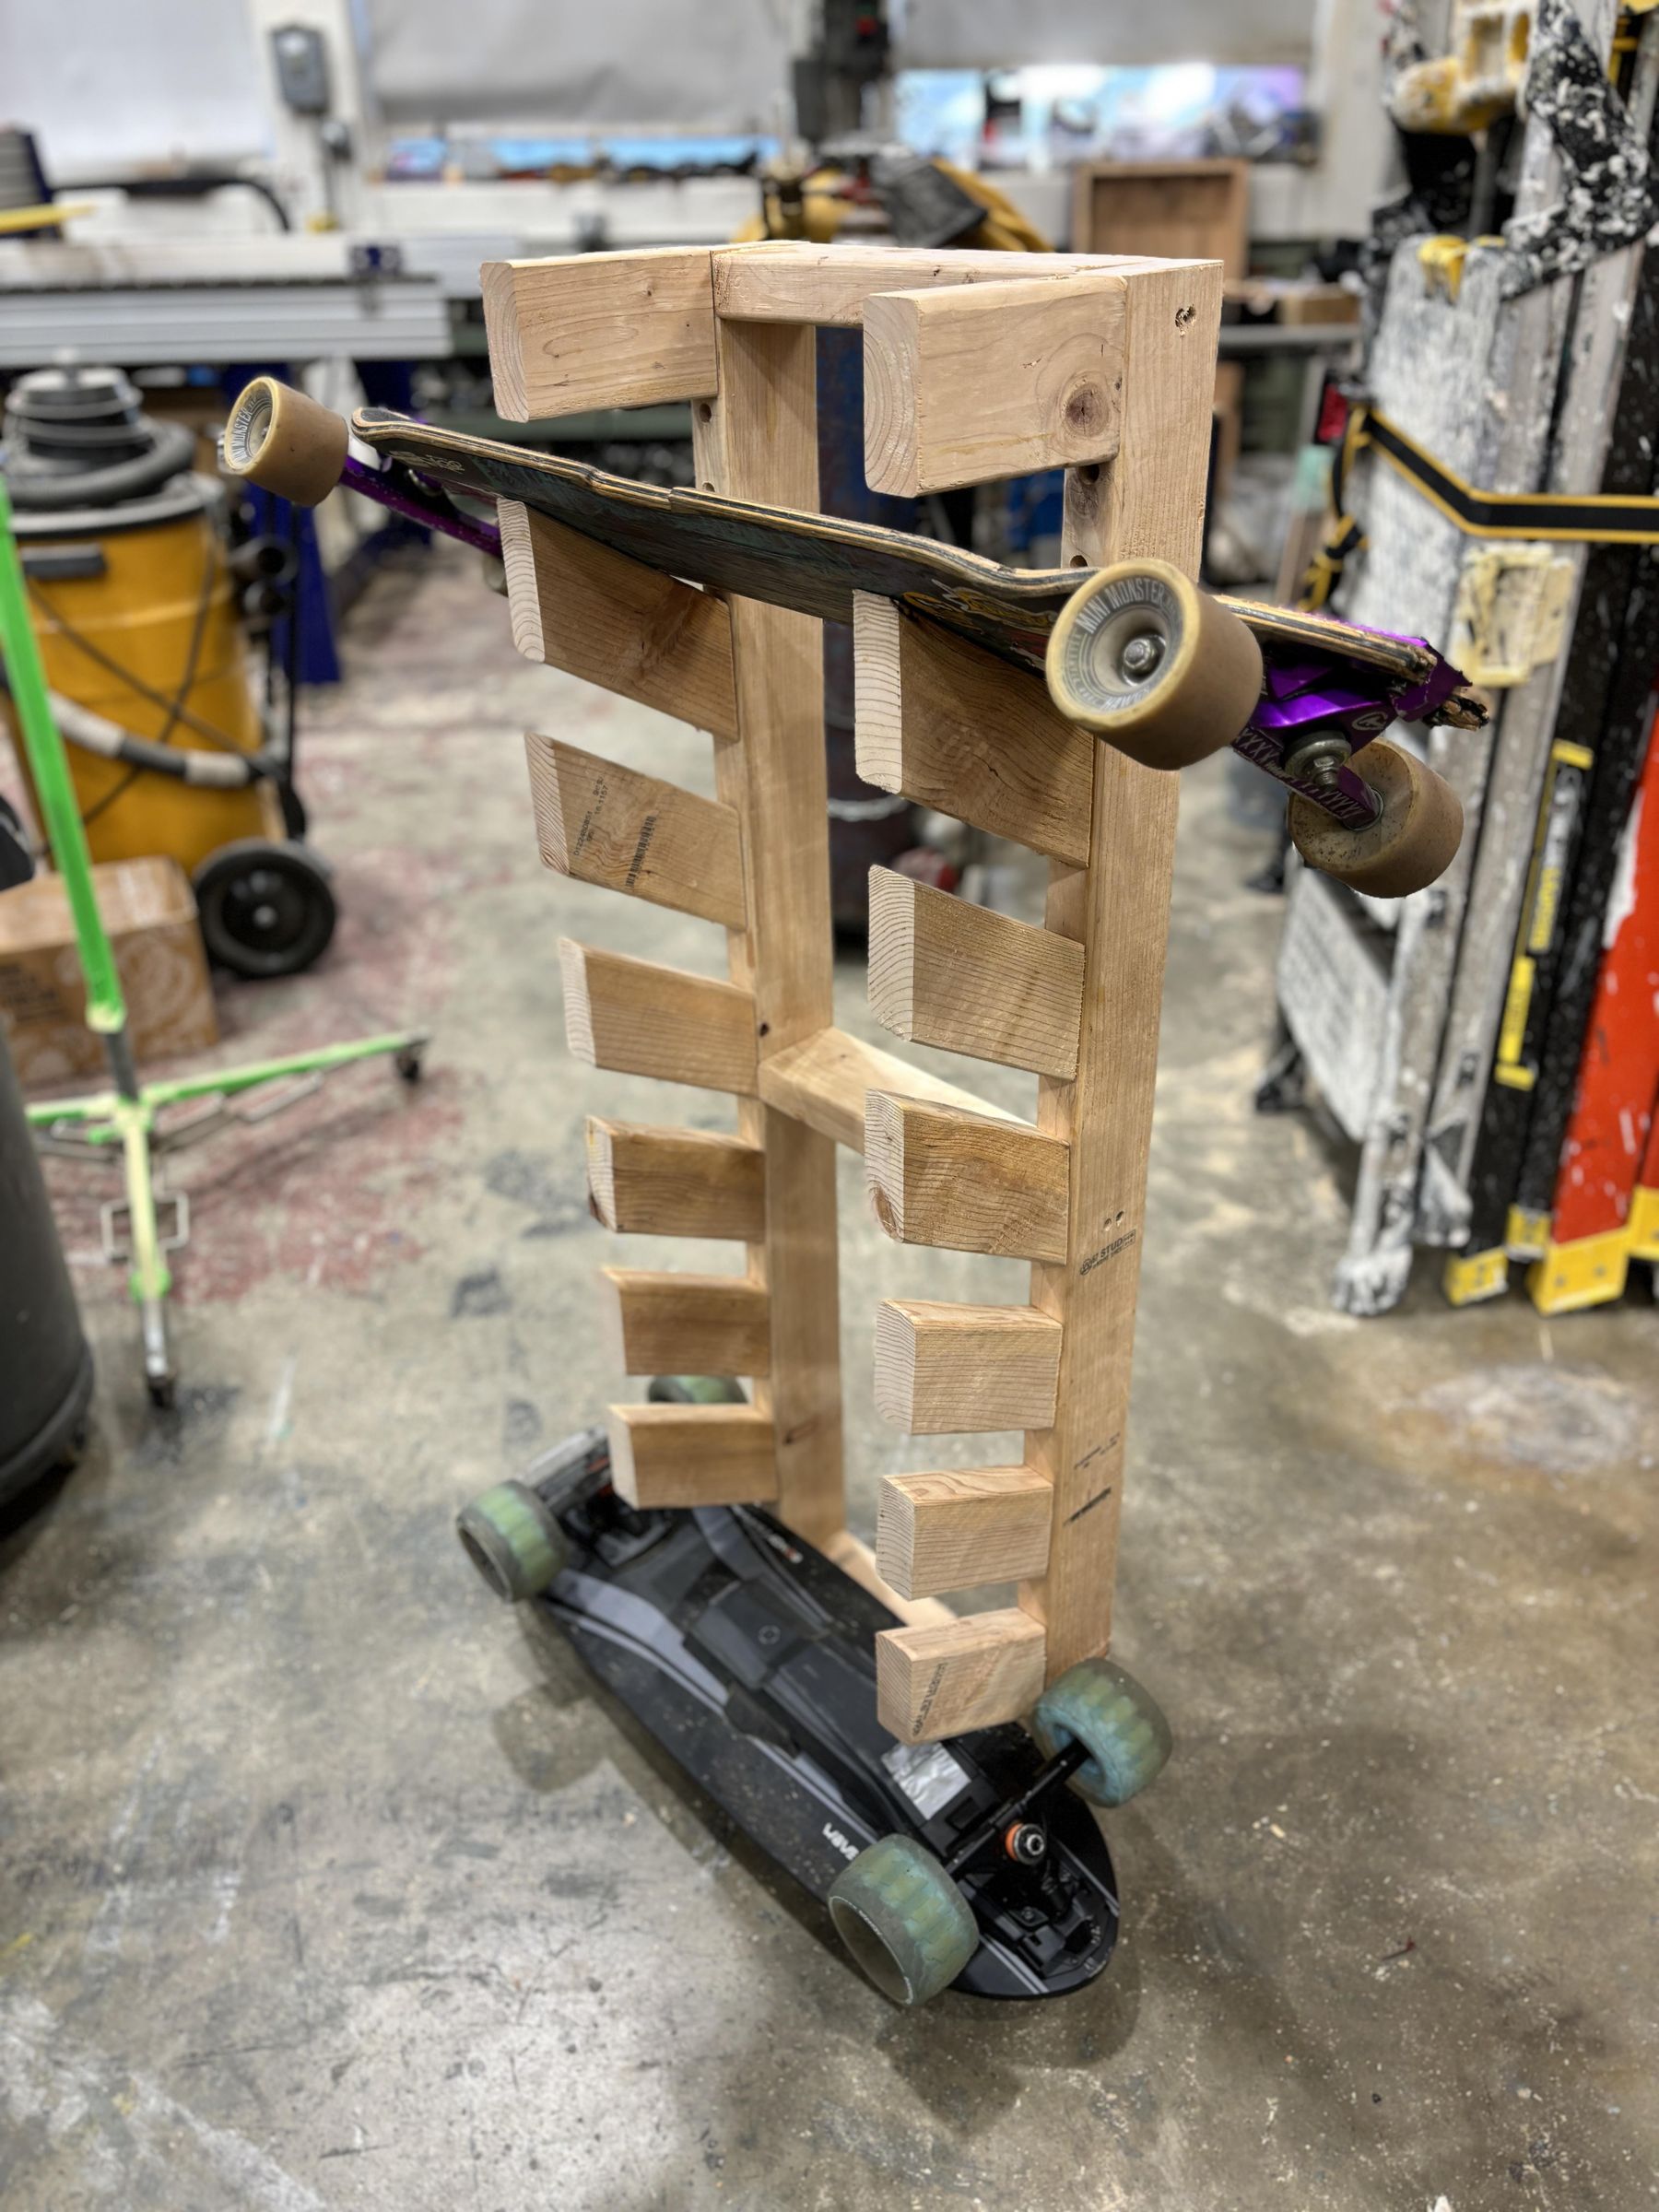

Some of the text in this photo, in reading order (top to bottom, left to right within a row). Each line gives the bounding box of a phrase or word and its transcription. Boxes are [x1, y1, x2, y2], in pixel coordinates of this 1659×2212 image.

[231, 406, 253, 446] MONSTER
[1075, 594, 1111, 634] MINI
[1105, 577, 1165, 610] MONSTER
[1100, 1237, 1124, 1258] STUD
